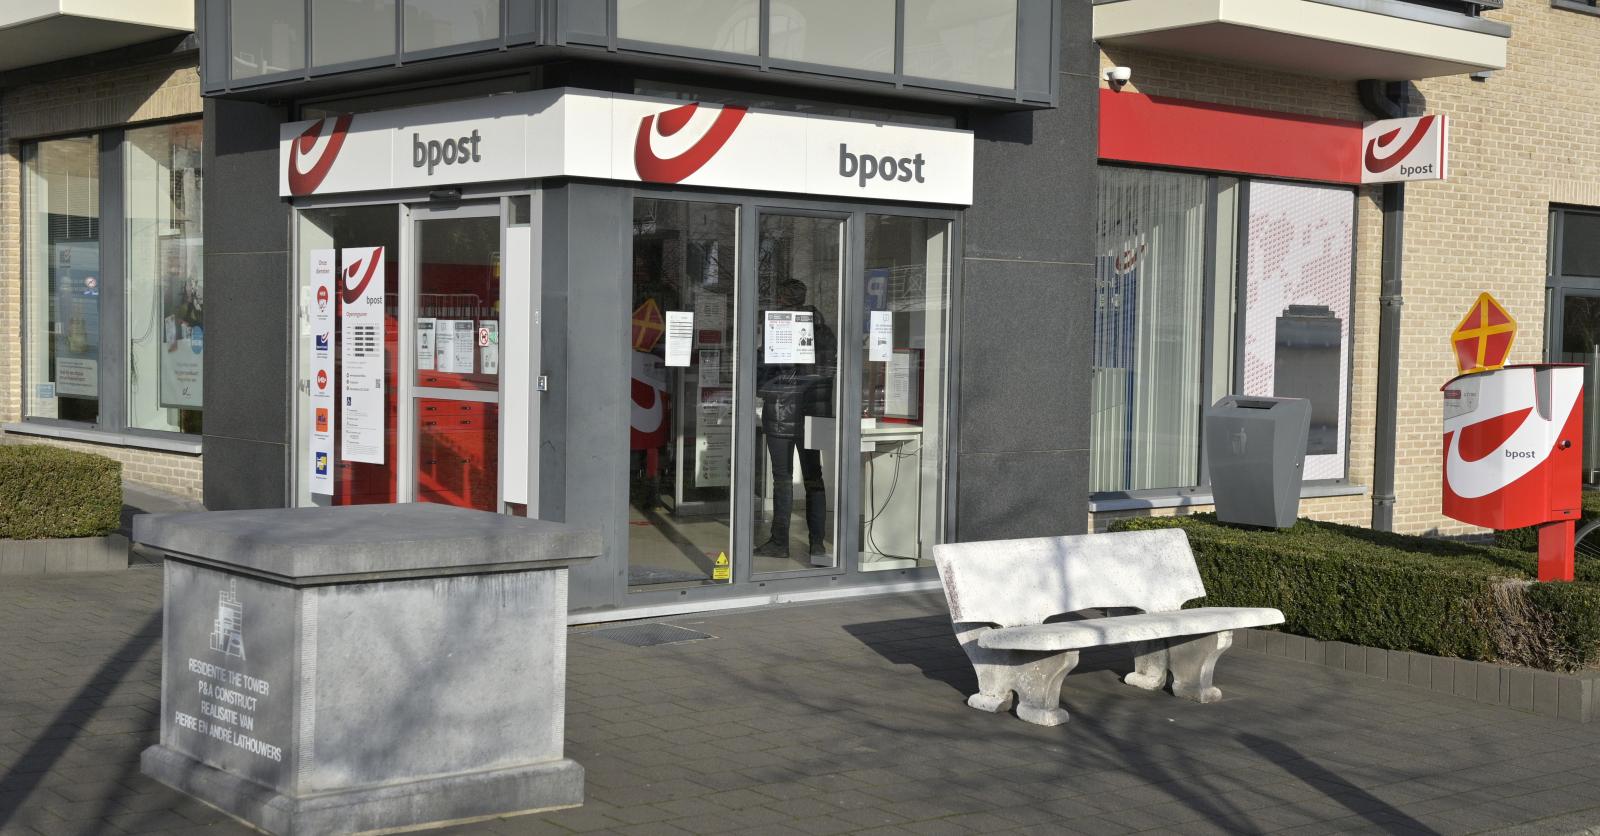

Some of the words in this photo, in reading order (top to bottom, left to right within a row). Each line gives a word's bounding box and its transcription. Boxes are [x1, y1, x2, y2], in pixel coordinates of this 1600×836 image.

[413, 129, 481, 176] bpost
[839, 143, 925, 187] bpost
[1400, 163, 1432, 177] bpost
[366, 295, 383, 307] bpost
[1505, 449, 1536, 460] bpost
[188, 657, 227, 682] RESIDENTIE
[228, 670, 242, 687] THE
[244, 675, 270, 697] TOWER
[198, 680, 214, 697] P&A
[214, 686, 258, 712] CONSTRUCT
[201, 701, 238, 726] REALISATIE
[239, 713, 254, 731] VAN
[175, 710, 198, 731] PIERRE
[198, 719, 208, 734] EN
[209, 725, 233, 744] ANDRÉ
[233, 732, 282, 762] LATHOUWERS
